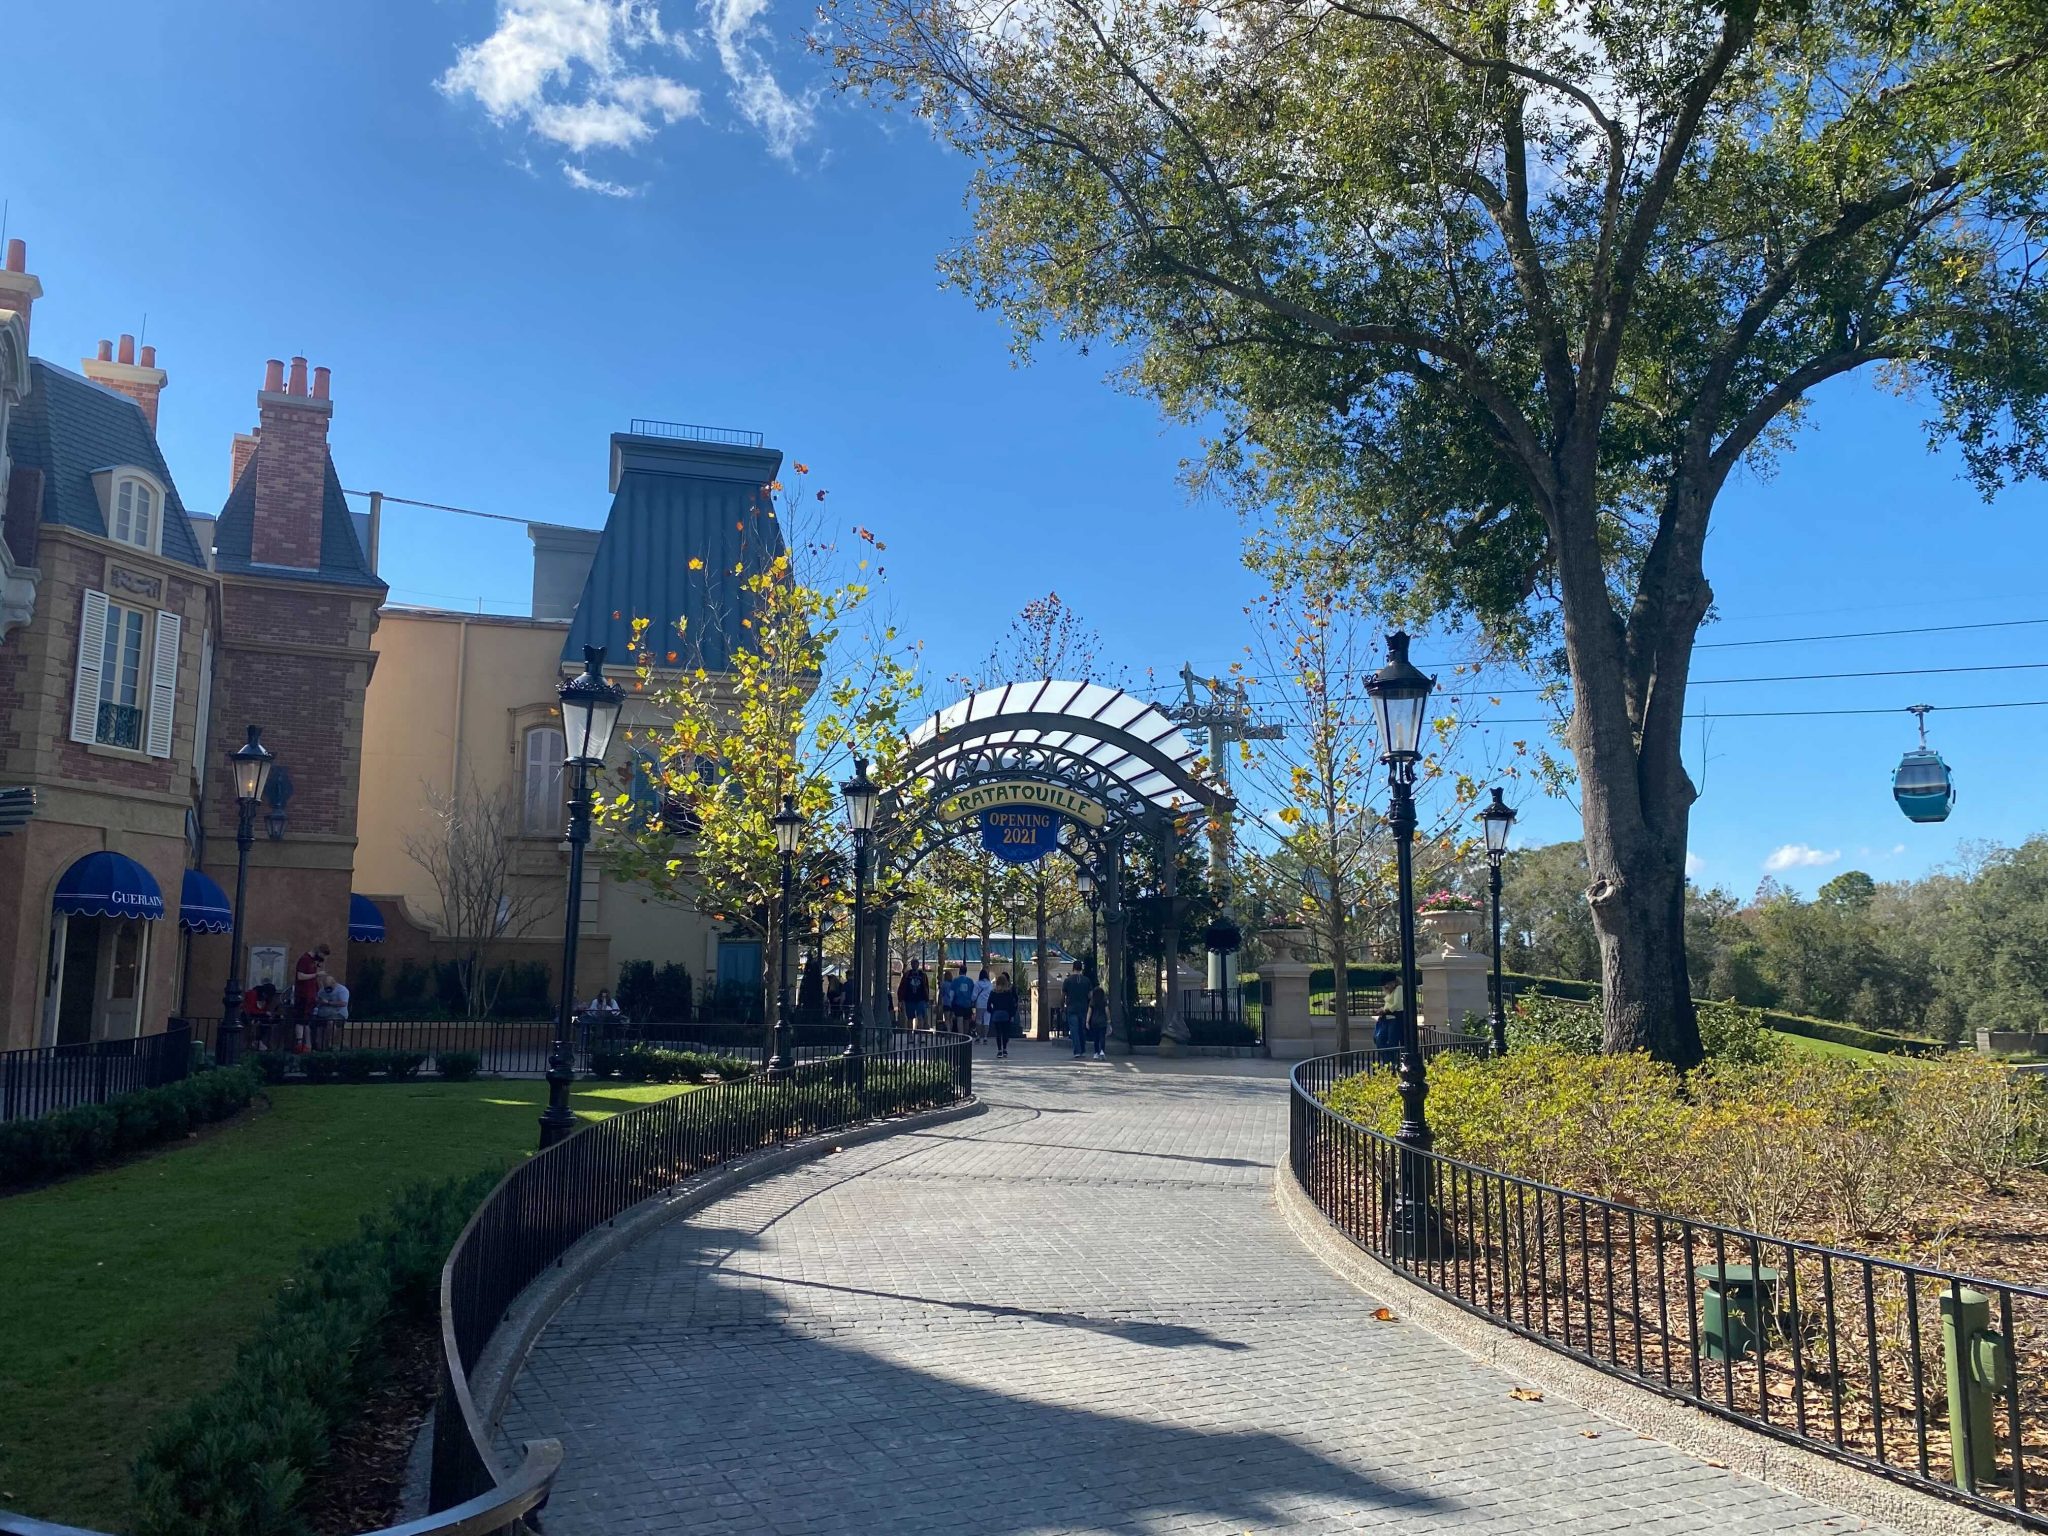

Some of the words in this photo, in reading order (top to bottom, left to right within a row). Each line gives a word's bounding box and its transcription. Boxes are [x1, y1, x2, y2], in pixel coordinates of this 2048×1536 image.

[958, 785, 1091, 817] RATATOUILLE
[989, 812, 1050, 828] OPENING
[1003, 828, 1037, 844] 2021
[111, 890, 162, 907] GUERLAIN
